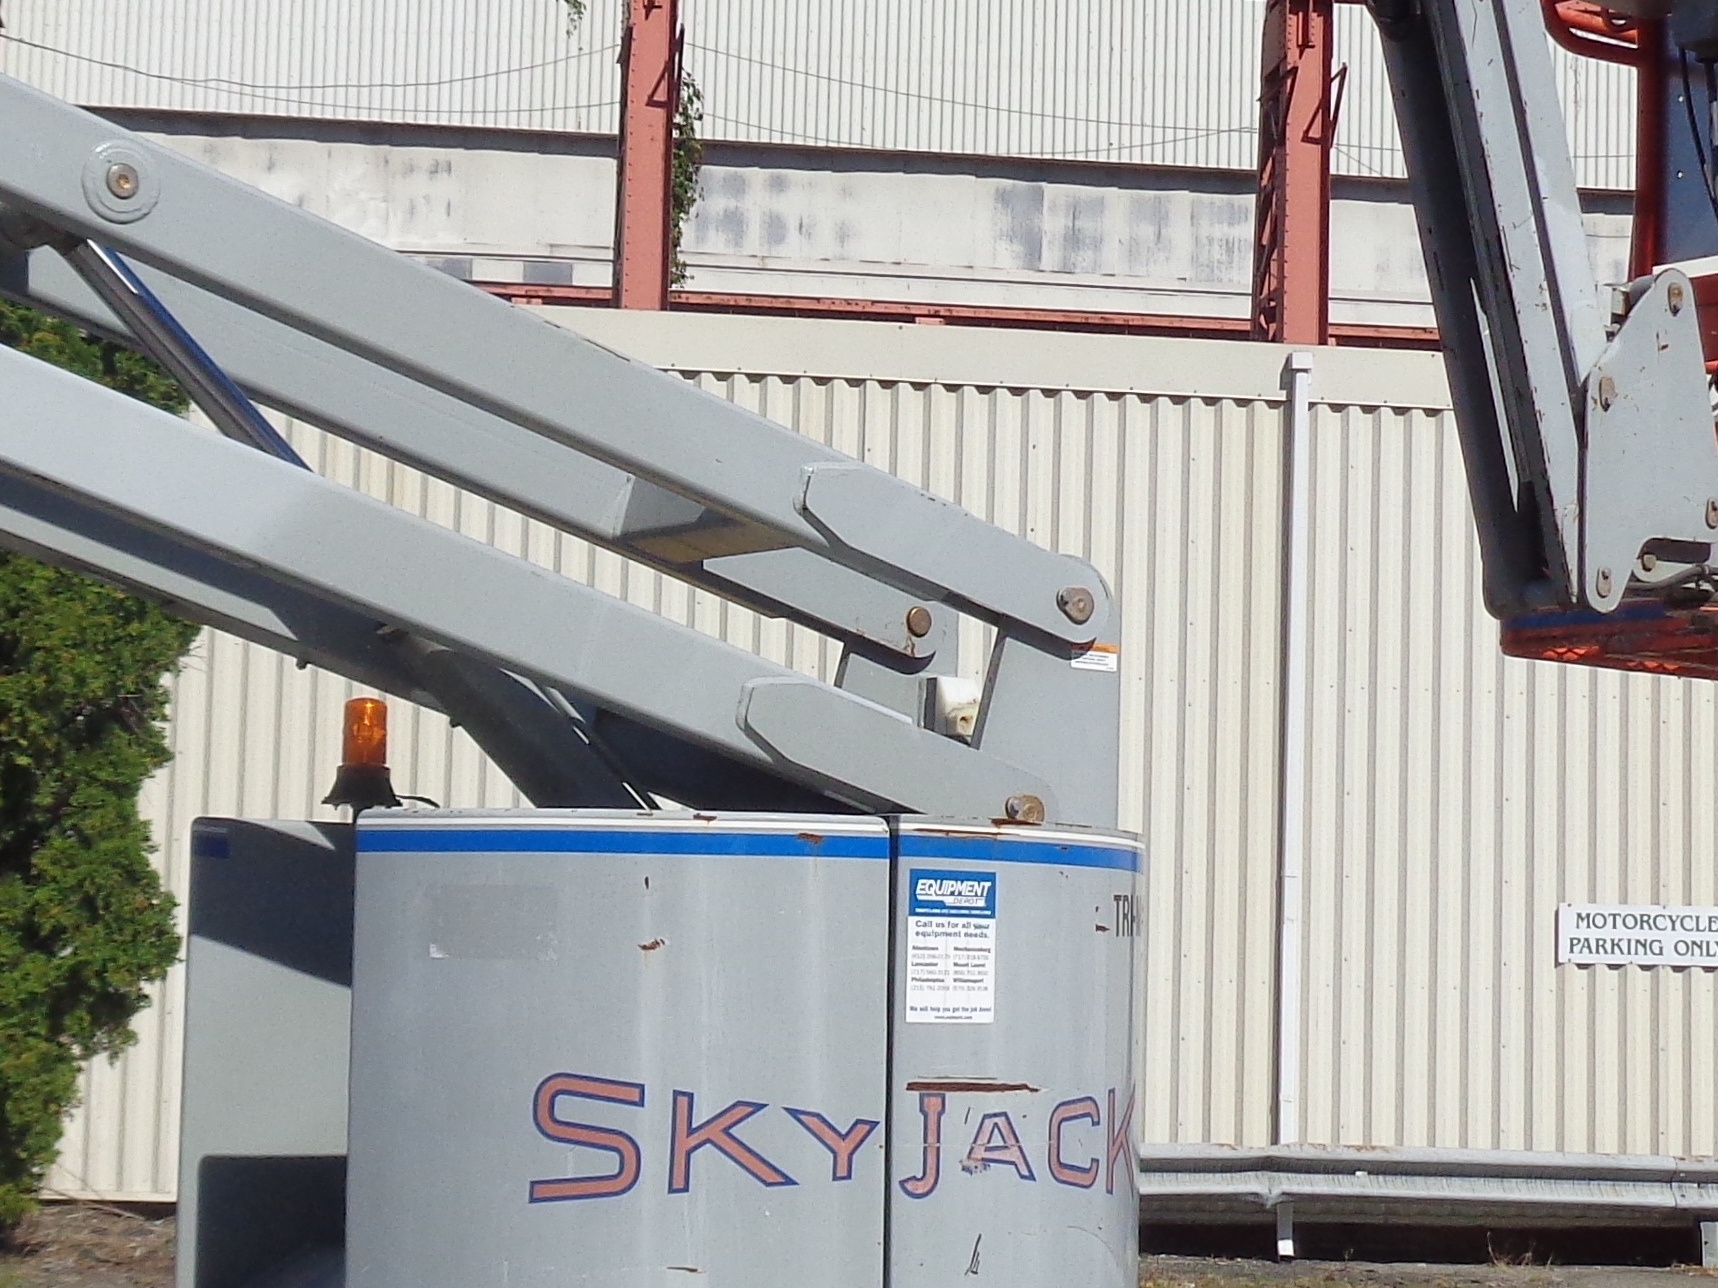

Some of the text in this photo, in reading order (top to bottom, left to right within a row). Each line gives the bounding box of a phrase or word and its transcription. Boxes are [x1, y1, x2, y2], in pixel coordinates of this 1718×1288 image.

[915, 879, 992, 898] EQUIPMENT
[953, 897, 983, 905] DEPOT
[915, 920, 933, 928] Call
[947, 921, 960, 929] for
[961, 921, 972, 929] all
[915, 930, 962, 938] equipment
[1569, 937, 1664, 957] PARKING
[528, 1071, 1136, 1204] SKYJACK
